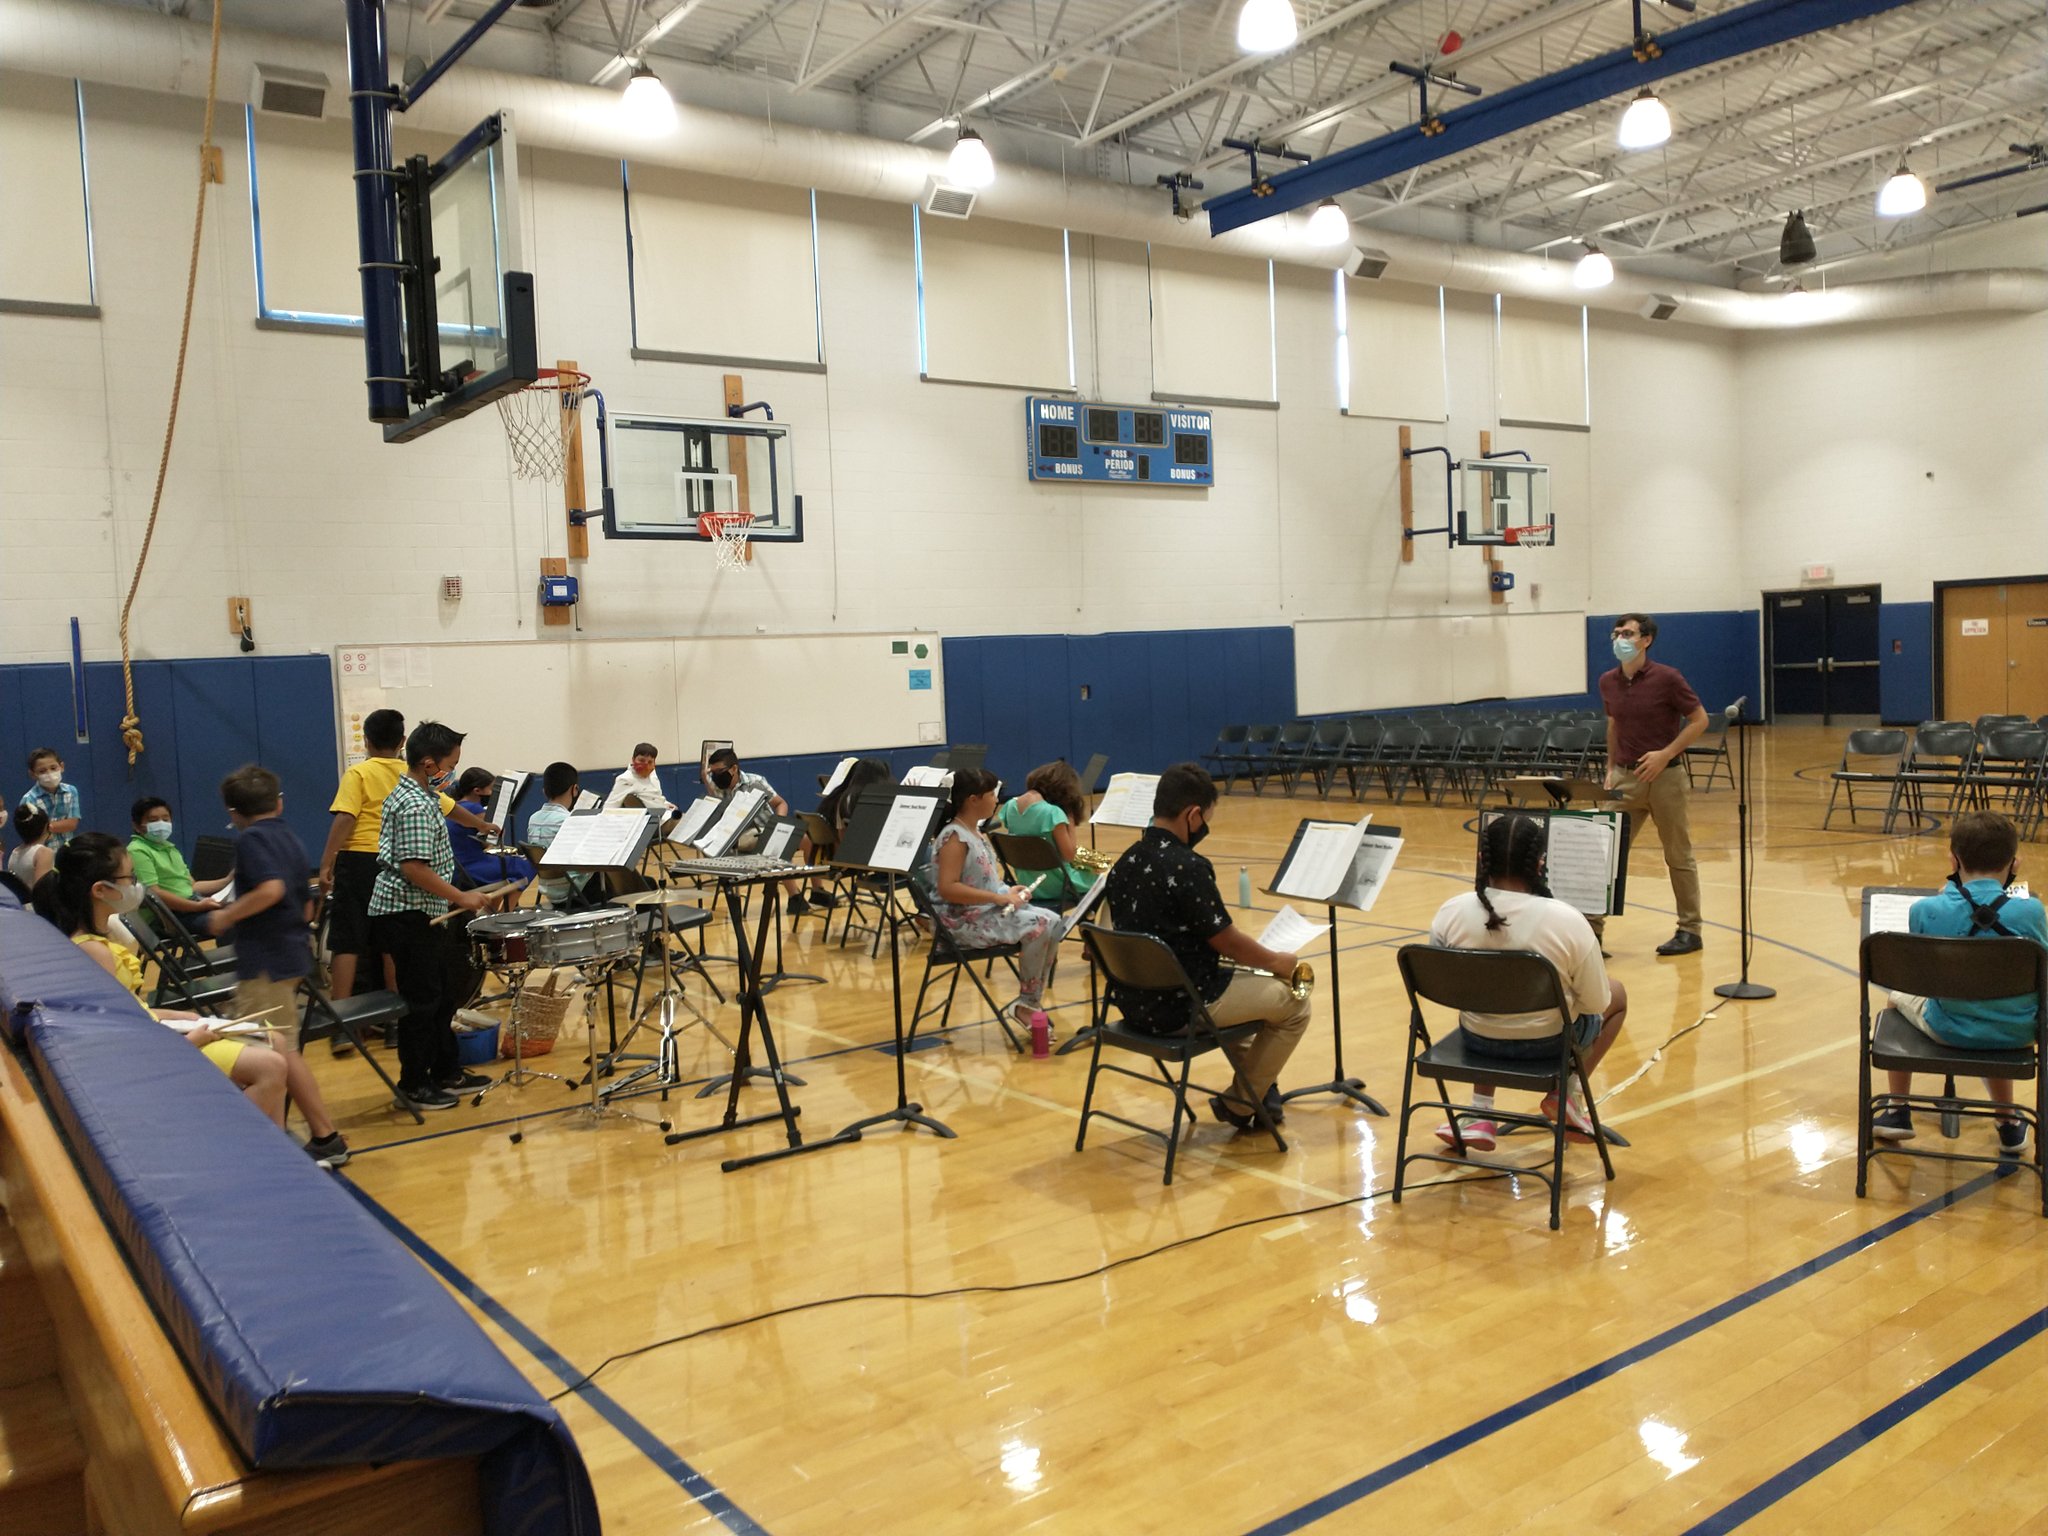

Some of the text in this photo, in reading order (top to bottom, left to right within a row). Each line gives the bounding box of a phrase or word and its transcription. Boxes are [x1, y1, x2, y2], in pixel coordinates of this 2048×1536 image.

[1041, 404, 1074, 420] HOME
[1170, 414, 1210, 430] VISITOR
[1111, 449, 1127, 458] POSS
[1055, 463, 1083, 476] BONUS
[1105, 458, 1134, 470] PERIOD
[1170, 468, 1196, 480] BONUS
